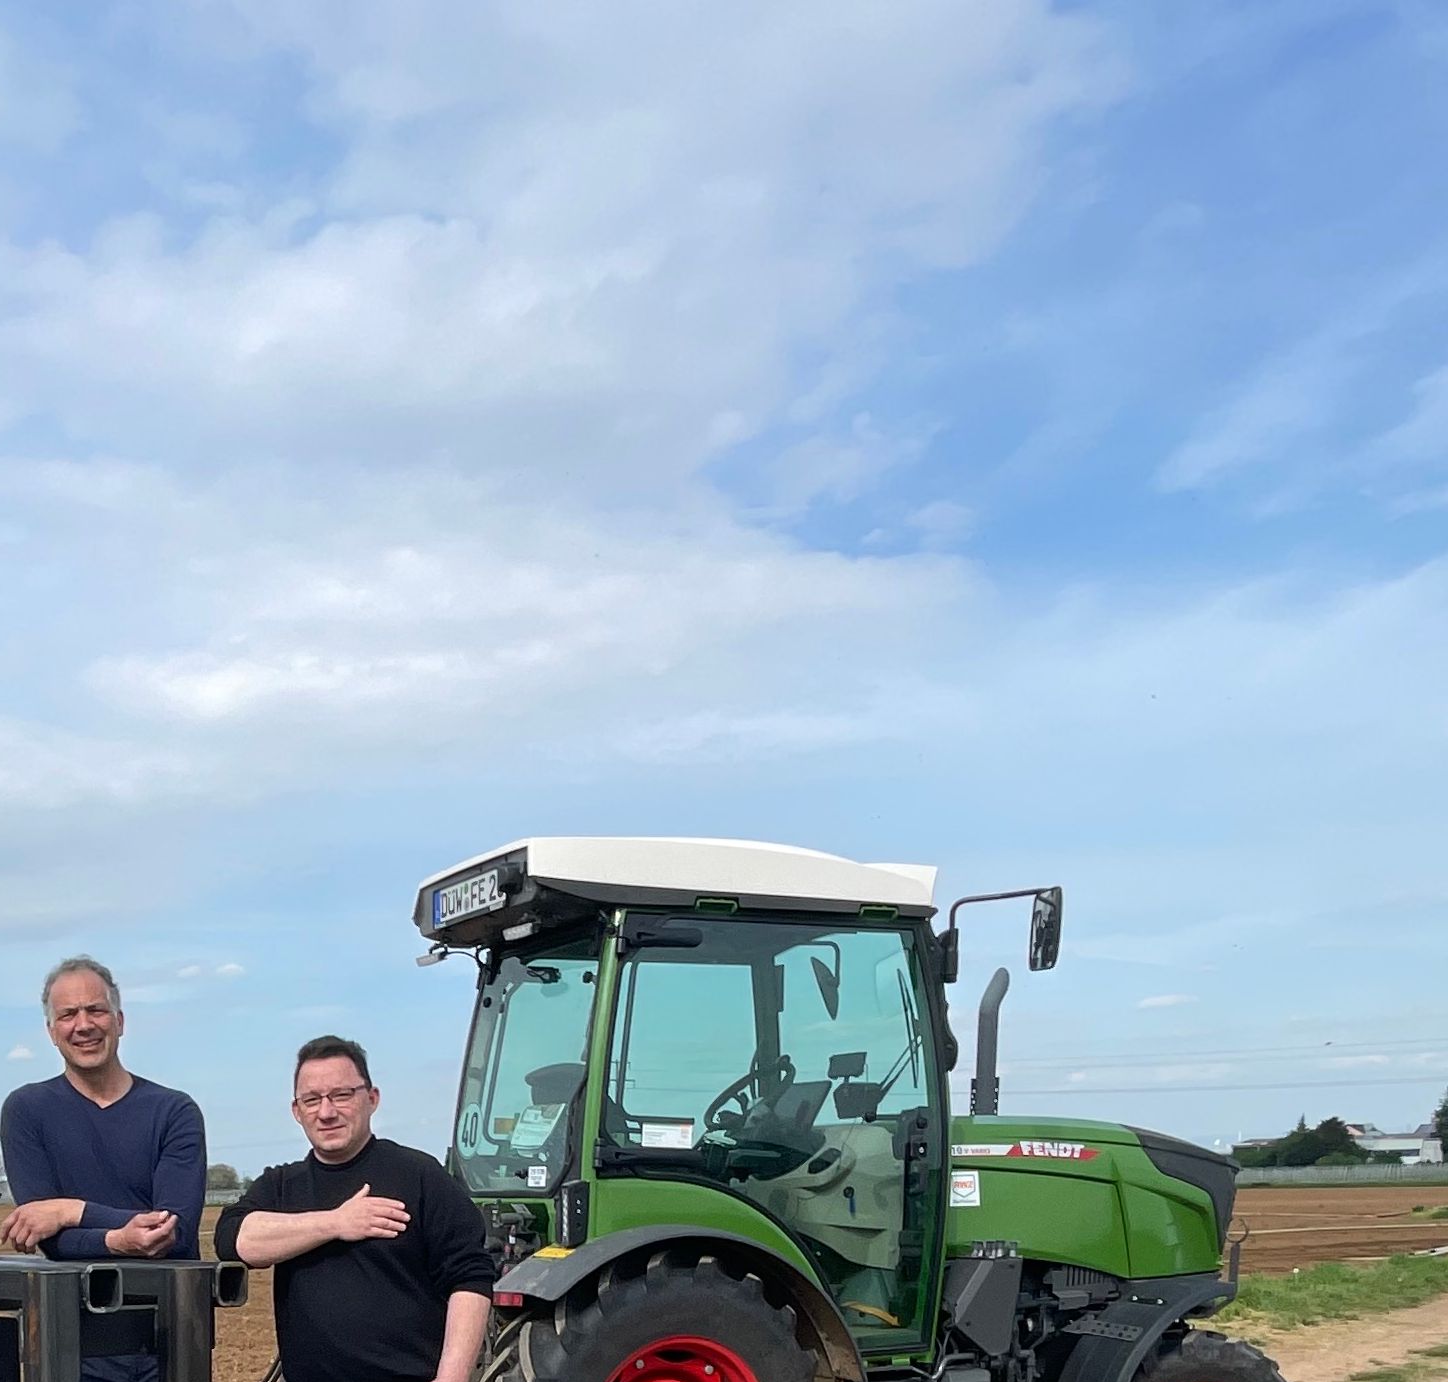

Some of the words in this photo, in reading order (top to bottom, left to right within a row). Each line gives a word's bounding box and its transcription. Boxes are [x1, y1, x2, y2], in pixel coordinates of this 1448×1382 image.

[441, 886, 463, 918] DÜW
[471, 878, 486, 908] FE
[462, 1112, 478, 1148] 40
[1019, 1140, 1085, 1159] FENDT
